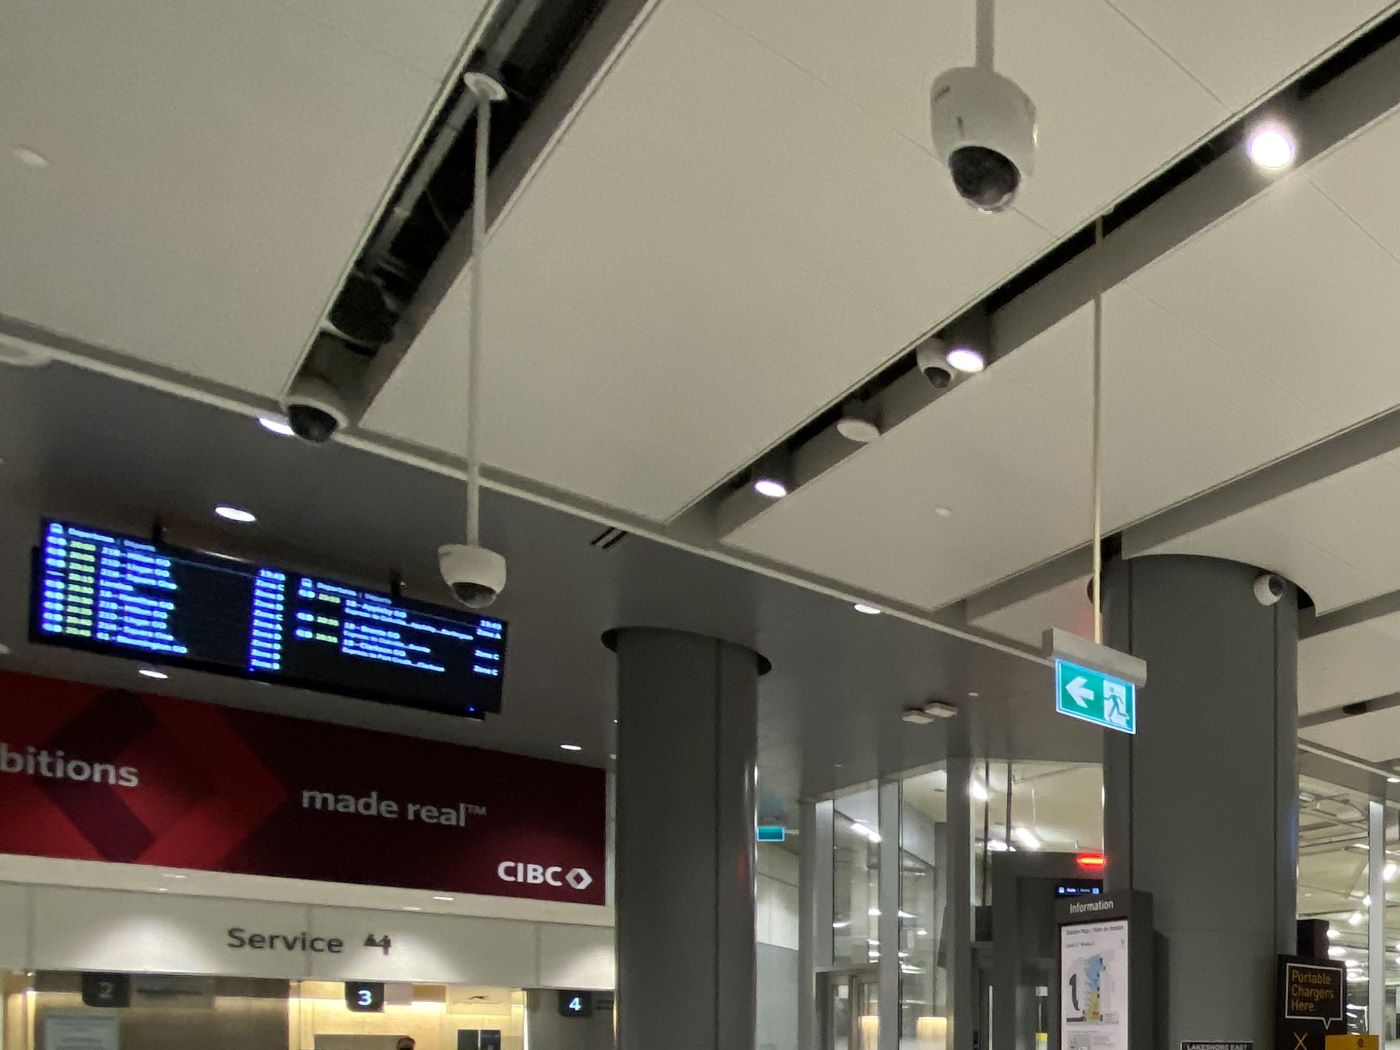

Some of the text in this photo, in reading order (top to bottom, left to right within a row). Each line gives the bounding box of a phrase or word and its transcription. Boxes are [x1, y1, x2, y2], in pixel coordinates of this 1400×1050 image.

[0, 741, 139, 787] bitions
[302, 790, 399, 819] made
[497, 861, 563, 887] CIBC
[1069, 900, 1114, 914] Information
[227, 927, 344, 954] Service
[1291, 969, 1332, 985] Portable
[97, 981, 114, 998] 2
[357, 989, 373, 1006] 3
[1291, 984, 1334, 1000] Chargers
[568, 997, 582, 1011] 4
[1291, 999, 1314, 1011] Here
